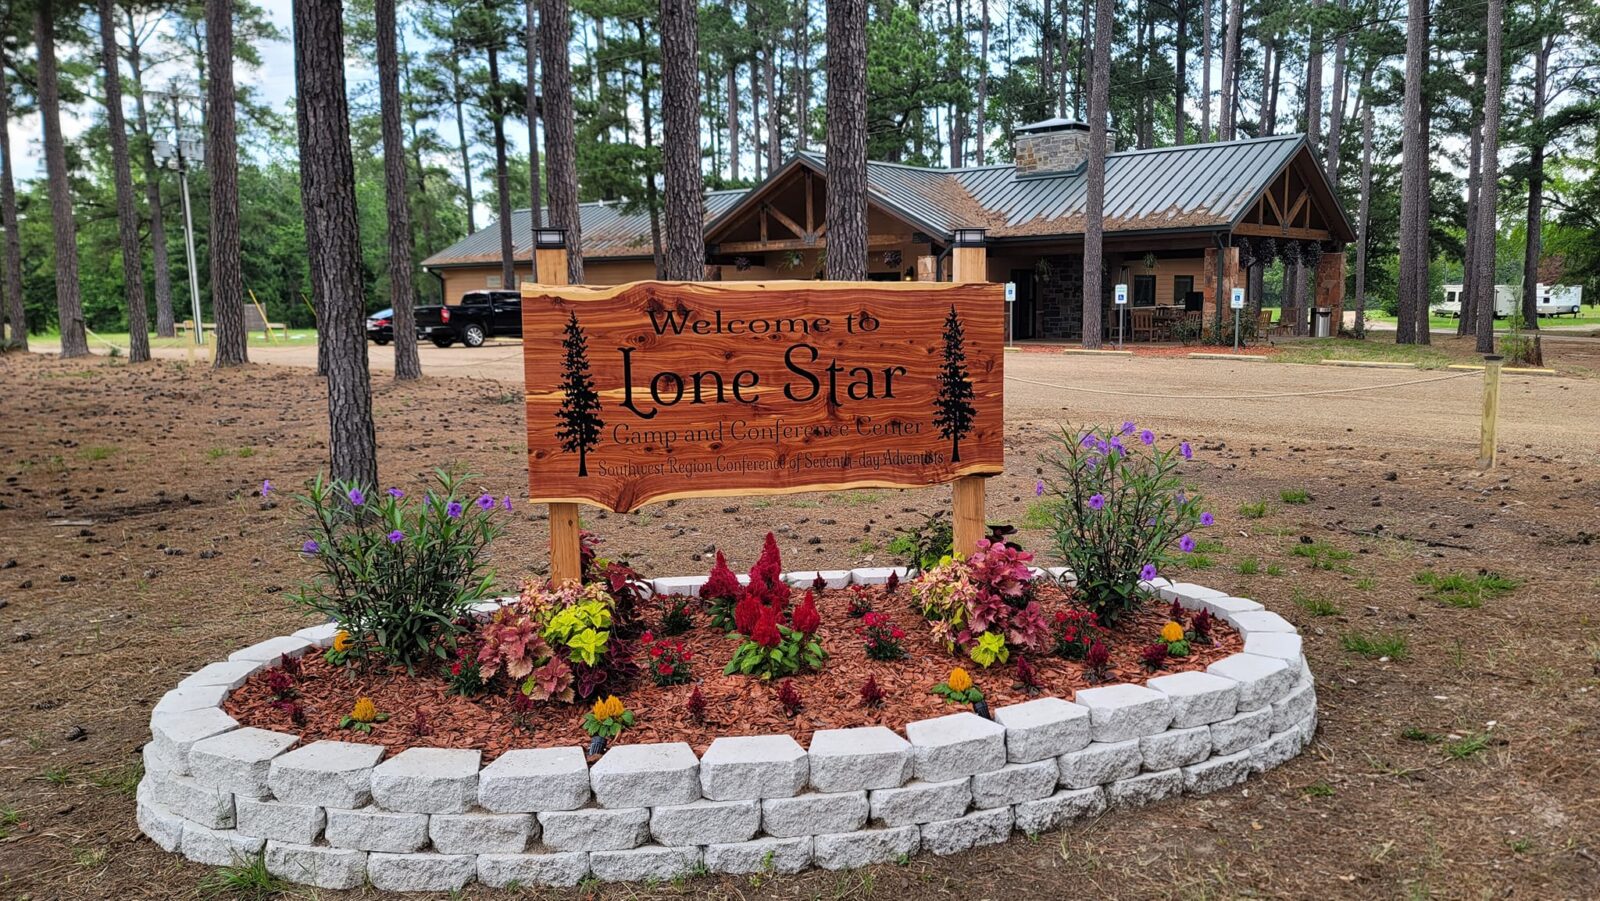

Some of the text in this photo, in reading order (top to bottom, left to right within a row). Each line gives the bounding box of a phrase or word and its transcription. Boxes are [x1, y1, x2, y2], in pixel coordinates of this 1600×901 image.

[646, 309, 880, 335] Welcome to
[618, 343, 907, 419] Lone Star
[613, 415, 924, 448] Camp and Conference Center
[598, 449, 944, 478] Southwest Region Conference of Seventh-day Adventists
